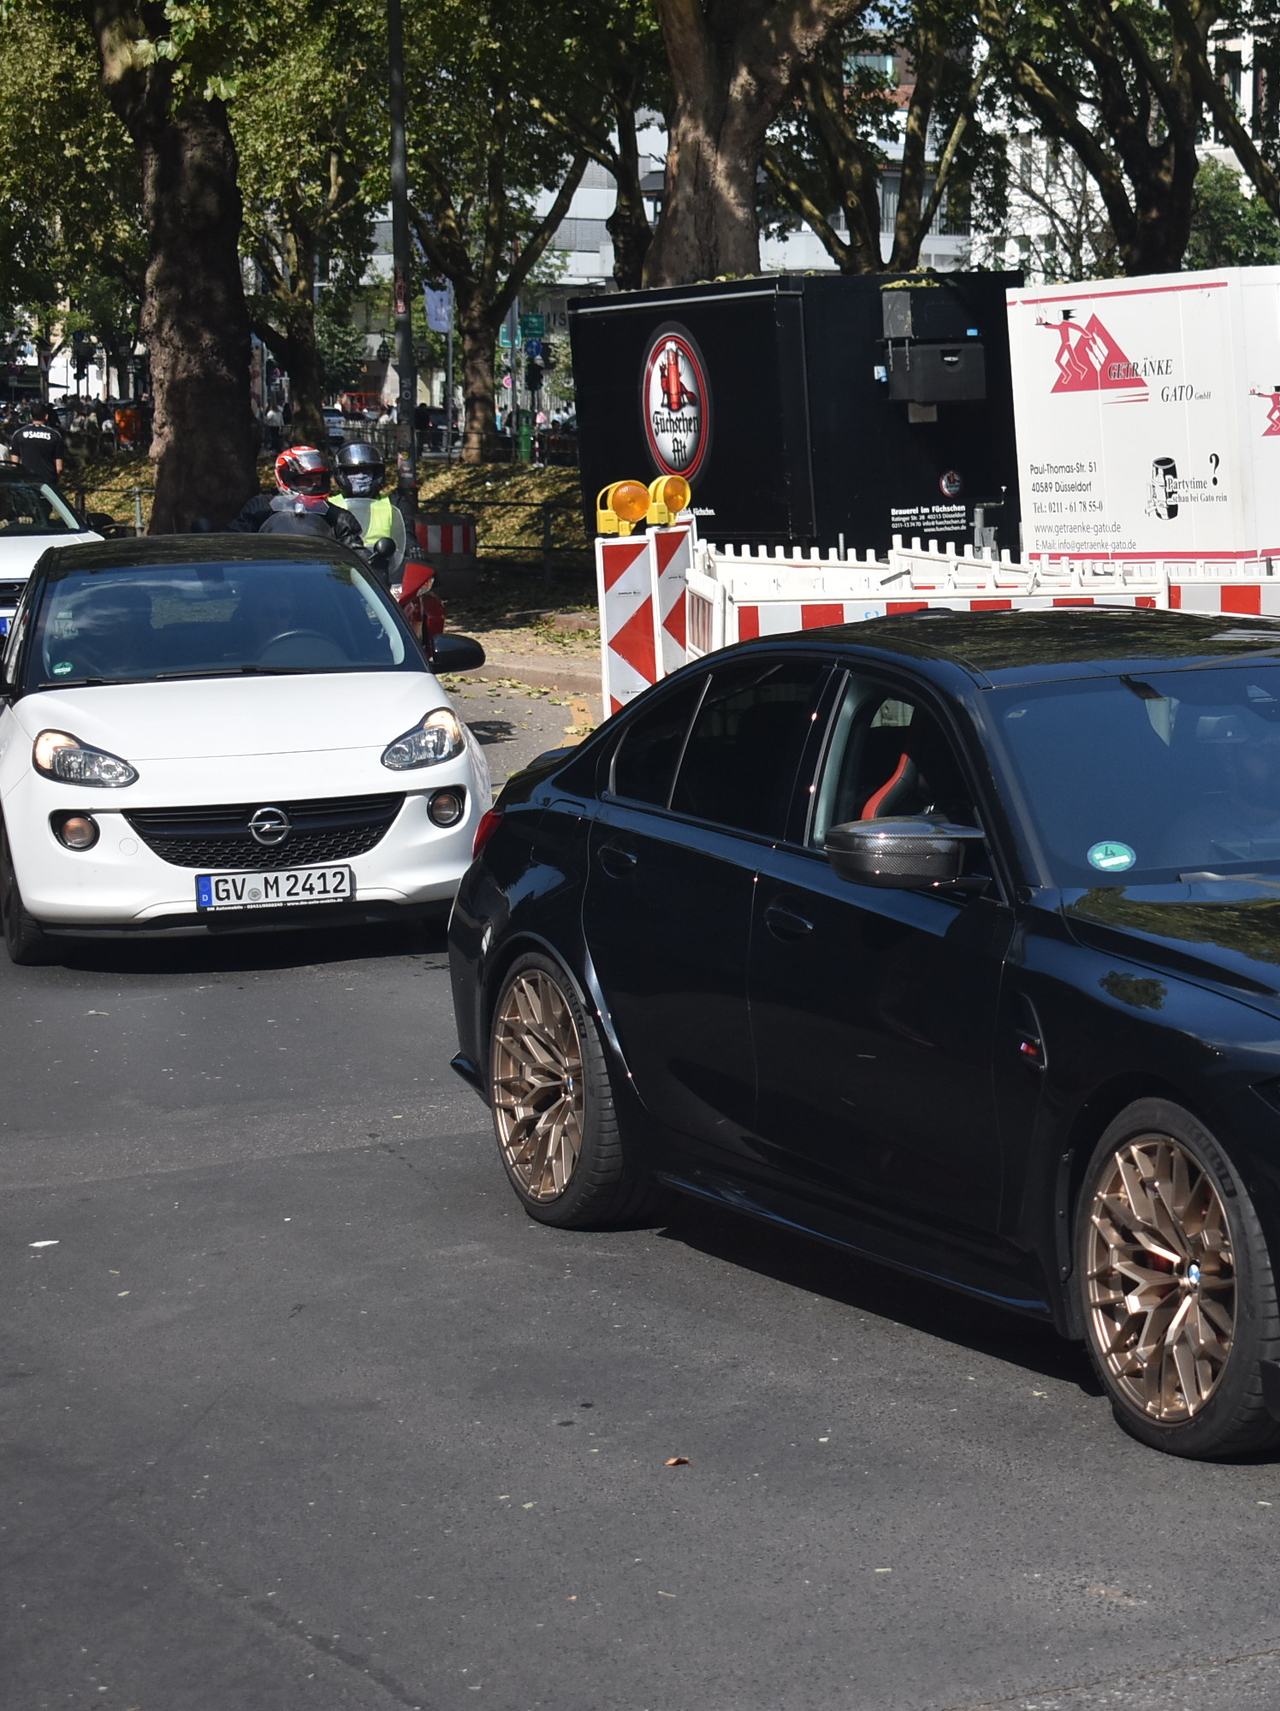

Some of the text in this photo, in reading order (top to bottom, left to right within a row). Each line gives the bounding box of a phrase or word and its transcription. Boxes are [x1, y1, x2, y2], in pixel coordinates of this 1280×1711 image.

[1108, 357, 1173, 380] GETRÄNKE
[1161, 385, 1212, 402] GATO GmbH
[28, 431, 51, 440] SAGRES
[672, 437, 687, 466] Alt
[1030, 461, 1097, 475] Paul-Thomas-Str. 51
[1031, 481, 1092, 493] 40589 Düsseldorf
[1167, 477, 1208, 493] Partytime
[1190, 493, 1199, 502] bei
[1200, 493, 1214, 502] Gato
[1216, 492, 1228, 502] rein
[891, 505, 966, 515] Brauerei im Füchschen
[1048, 502, 1063, 513] 0211
[1069, 501, 1077, 513] 61
[1079, 501, 1087, 512] 78
[1088, 500, 1104, 512] 55-0
[1058, 539, 1137, 552] info@getraenke-gato.de
[1105, 846, 1116, 857] 4
[214, 878, 246, 901] GV
[264, 876, 280, 899] M
[285, 871, 346, 896] 2412
